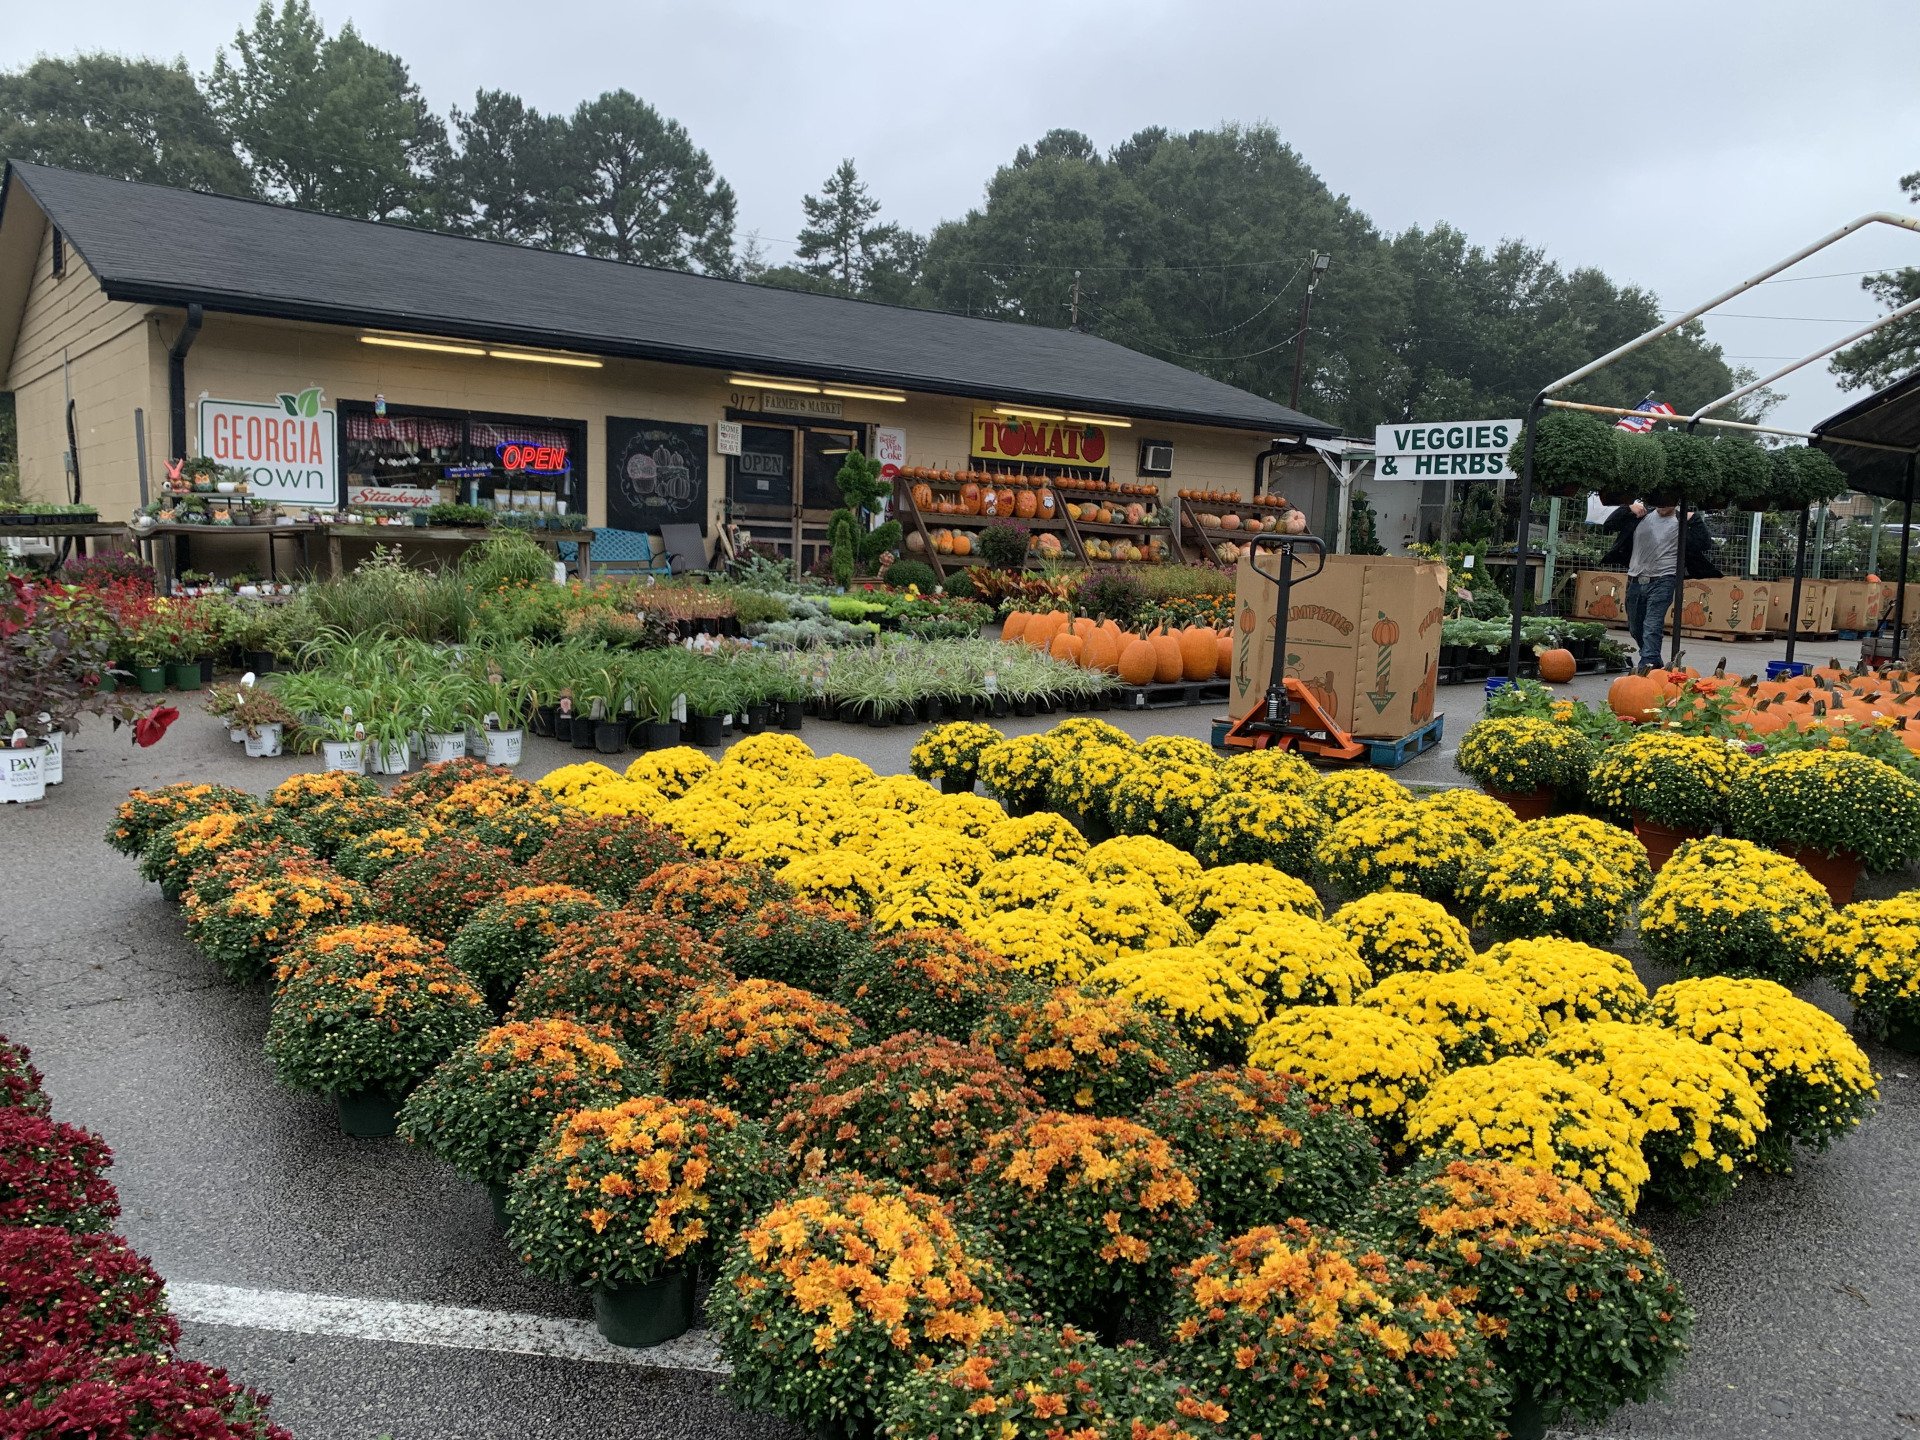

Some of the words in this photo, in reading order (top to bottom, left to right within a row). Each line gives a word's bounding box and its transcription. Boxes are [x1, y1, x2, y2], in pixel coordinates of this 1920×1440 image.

[731, 393, 756, 411] 917
[764, 395, 806, 410] FARMER'S
[808, 400, 843, 415] MARKET
[213, 413, 323, 465] GEORGIA
[720, 423, 740, 435] HOME
[978, 415, 1106, 463] TOMATO
[1393, 425, 1509, 451] VEGGIES
[503, 445, 566, 470] OPEN
[743, 454, 781, 473] OPEN
[880, 448, 903, 461] Coke
[1381, 455, 1398, 475] &
[1415, 453, 1503, 475] HERBS
[240, 466, 324, 489] rown
